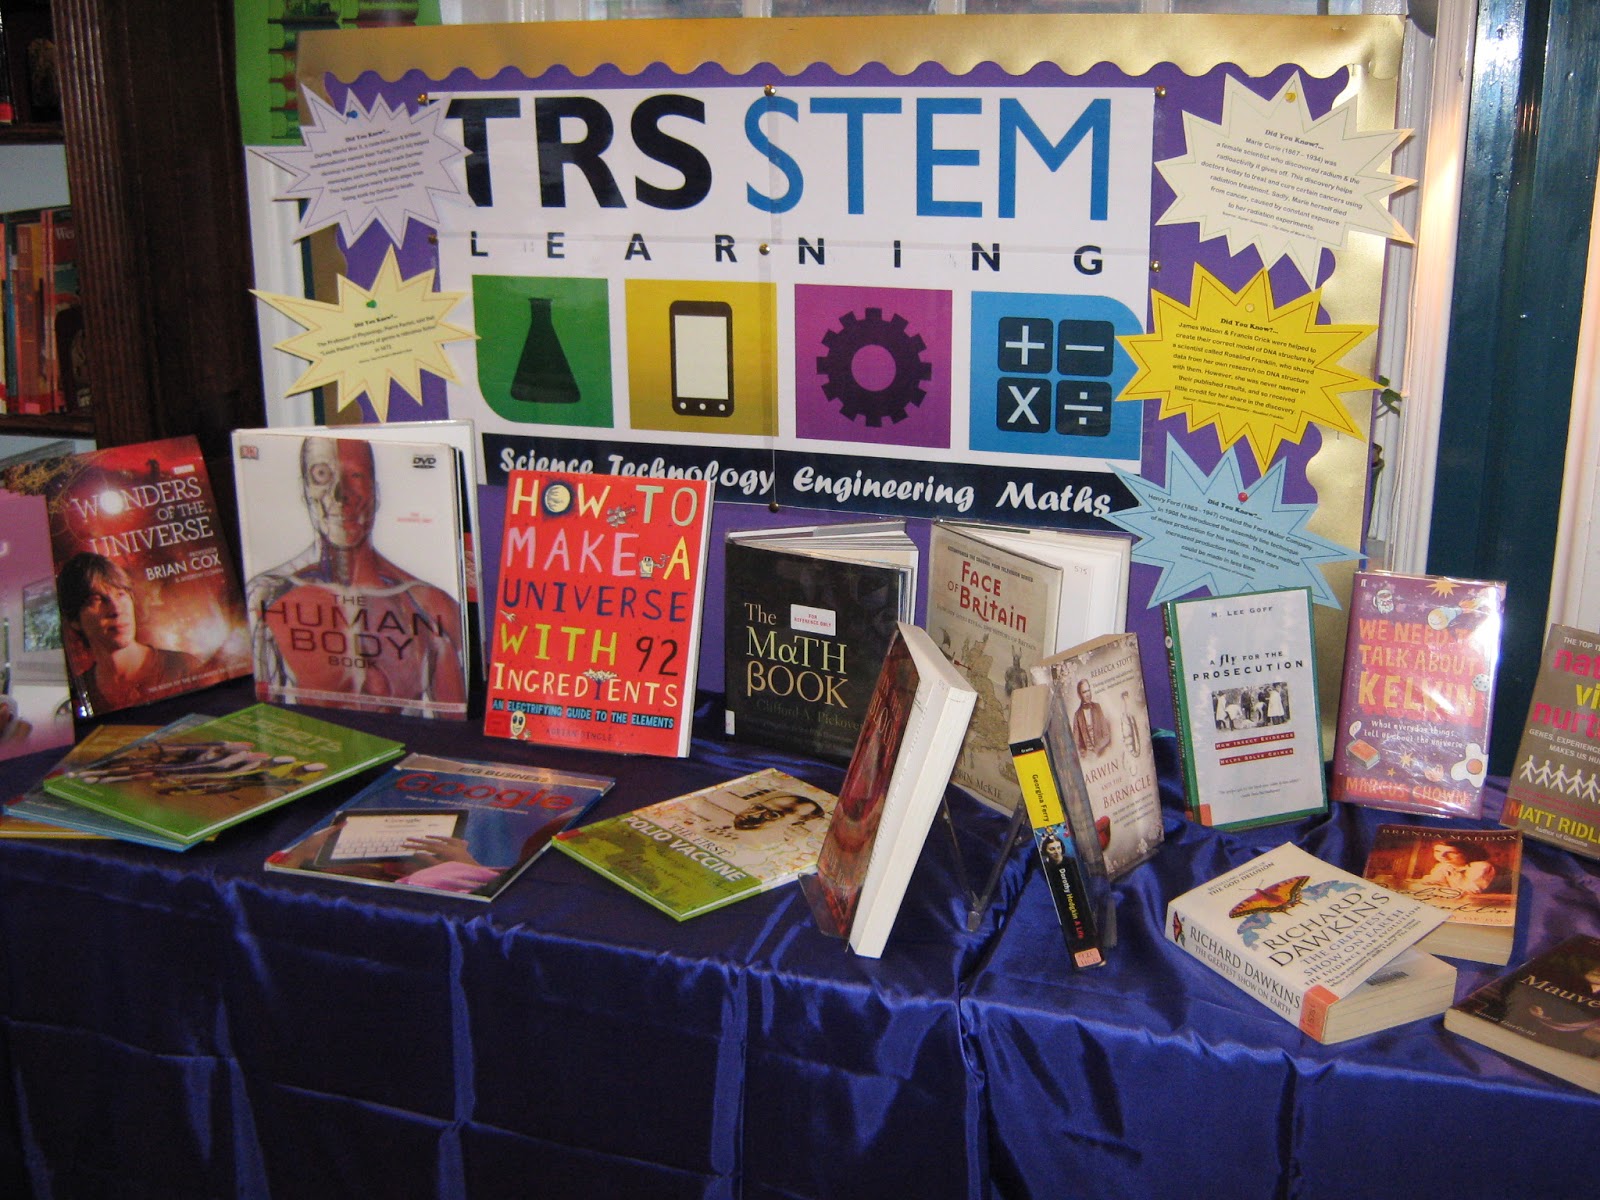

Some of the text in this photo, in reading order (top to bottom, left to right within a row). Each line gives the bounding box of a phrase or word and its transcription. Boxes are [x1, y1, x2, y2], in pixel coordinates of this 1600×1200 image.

[1265, 129, 1277, 137] Did
[1279, 133, 1292, 141] You
[448, 95, 713, 211] TRS
[746, 96, 1109, 221] STEM
[1245, 138, 1262, 146] Marie
[1264, 142, 1280, 151] Curie
[1306, 153, 1322, 162] 1934)
[471, 231, 1104, 275] LEARNING
[1179, 322, 1198, 330] James
[1200, 326, 1222, 334] Watson
[1230, 331, 1252, 339] Francis
[1288, 343, 1308, 351] helped
[413, 457, 436, 465] DVD
[500, 447, 1111, 518] Science Technology Engineering Maths
[157, 500, 206, 522] OF THE
[512, 477, 698, 527] HOW TO
[90, 516, 213, 557] UNIVERSE
[146, 559, 186, 581] BRIAN
[191, 552, 221, 570] COX
[506, 526, 691, 581] MAKE A
[948, 580, 959, 593] OF
[962, 560, 1001, 597] FACE
[334, 594, 367, 606] THE
[503, 577, 688, 622] UNIVERSE
[744, 602, 777, 625] The
[1250, 605, 1273, 613] GOFF
[261, 600, 444, 637] HUMAN
[1359, 618, 1449, 646] WE NEED
[291, 629, 414, 660] BODY
[500, 623, 679, 676] WITH 92
[1564, 637, 1593, 650] THE TOP
[328, 656, 379, 669] BOOK
[1090, 656, 1133, 678] REBECCA STOTT
[1193, 660, 1303, 681] PROSECUTION
[1219, 652, 1237, 668] fly
[1359, 644, 1478, 677] TALK ABOUT
[493, 662, 678, 708] INGREDIENTS
[1358, 670, 1476, 717] KELVIN
[1575, 683, 1600, 710] vi
[492, 699, 674, 728] AN ELECTRIFYING GUIDE TO THE ELEMENTS
[757, 699, 799, 717] Clifford
[1233, 737, 1257, 746] INSECT
[1260, 732, 1294, 742] EVIDENCE
[1364, 729, 1380, 738] tell
[1392, 732, 1414, 742] about
[1417, 735, 1429, 744] the
[1431, 738, 1463, 749] universe
[1394, 721, 1429, 735] everyday
[1529, 728, 1554, 741] GENES,
[1220, 757, 1241, 765] HELPS
[1244, 753, 1265, 761] SOLVE
[1549, 744, 1587, 760] MAKES US
[485, 770, 550, 782] BUSINESS
[1086, 758, 1119, 785] ARWIN
[396, 772, 574, 810] Google
[1032, 774, 1050, 822] Georgina Ferry
[1103, 775, 1151, 809] BARNACLE
[1346, 777, 1466, 805] MARCUS CHOWN
[1509, 801, 1556, 828] MATT
[621, 816, 747, 882] POLIO VACCINE
[669, 823, 730, 857] THE FIRST
[1381, 829, 1517, 843] BRENDA MADDOX
[1535, 826, 1588, 847] Author of Genome
[1058, 868, 1070, 894] Dorothy
[1066, 893, 1079, 920] Hodgkin
[1263, 891, 1363, 951] RICHARD
[1267, 892, 1390, 967] DAWKINS
[1301, 949, 1328, 965] THE
[1329, 911, 1387, 951] GREATEST
[1303, 909, 1406, 977] SHOW ON EARTH
[1304, 976, 1321, 986] THE
[1323, 951, 1361, 977] EVIDENCE
[1362, 940, 1377, 951] FOR
[1378, 905, 1421, 939] EVOLUTION
[1190, 926, 1301, 1009] RICHARD DAWKINS
[1195, 945, 1206, 957] THE
[1207, 954, 1236, 978] GREATEST
[1238, 974, 1257, 992] SHOW
[1258, 989, 1268, 999] ON
[1270, 994, 1291, 1015] EARTH
